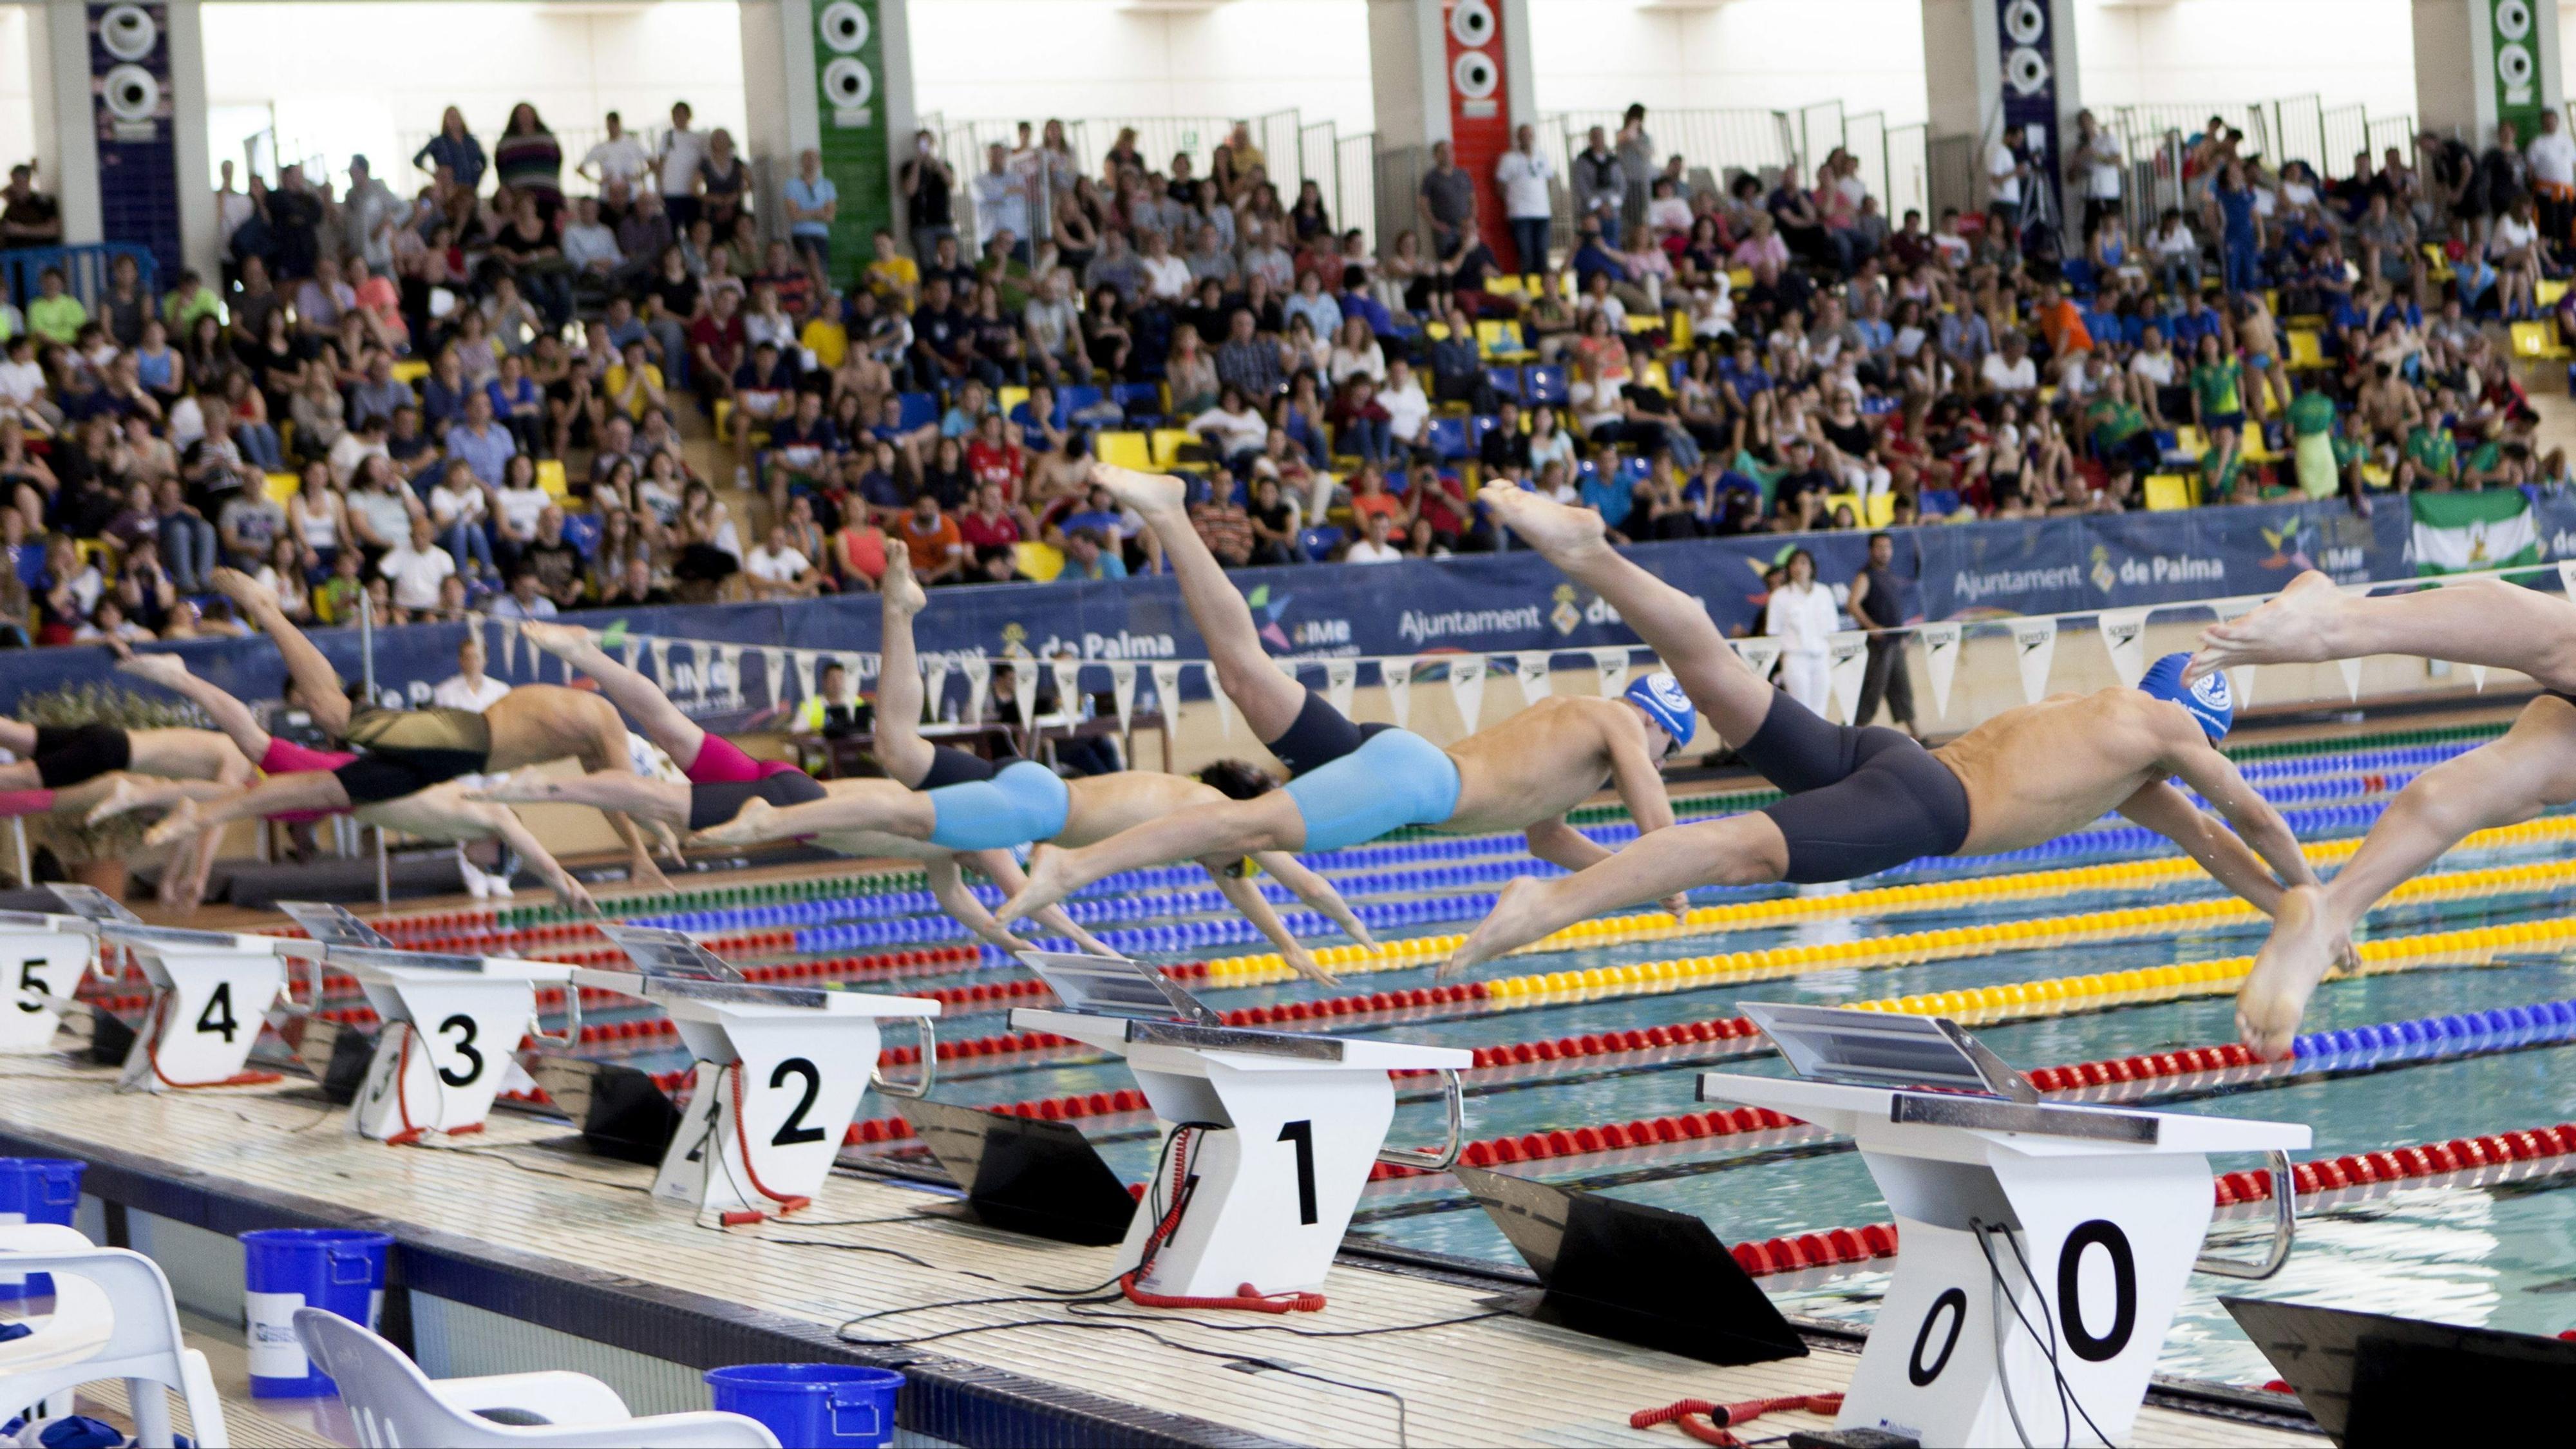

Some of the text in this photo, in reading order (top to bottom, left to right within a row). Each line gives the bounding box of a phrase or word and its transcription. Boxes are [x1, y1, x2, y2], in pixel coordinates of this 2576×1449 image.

[1953, 553, 2225, 604] Ajuntament de Palma
[1083, 629, 1175, 663] Palma
[1397, 605, 1542, 645] Ajuntament
[17, 958, 50, 1012] 5
[196, 982, 238, 1043] 4
[438, 1014, 484, 1088] 3
[769, 1057, 826, 1147] 2
[1277, 1119, 1318, 1226] 1
[2058, 1219, 2137, 1362] 0
[1908, 1287, 1967, 1387] 0
